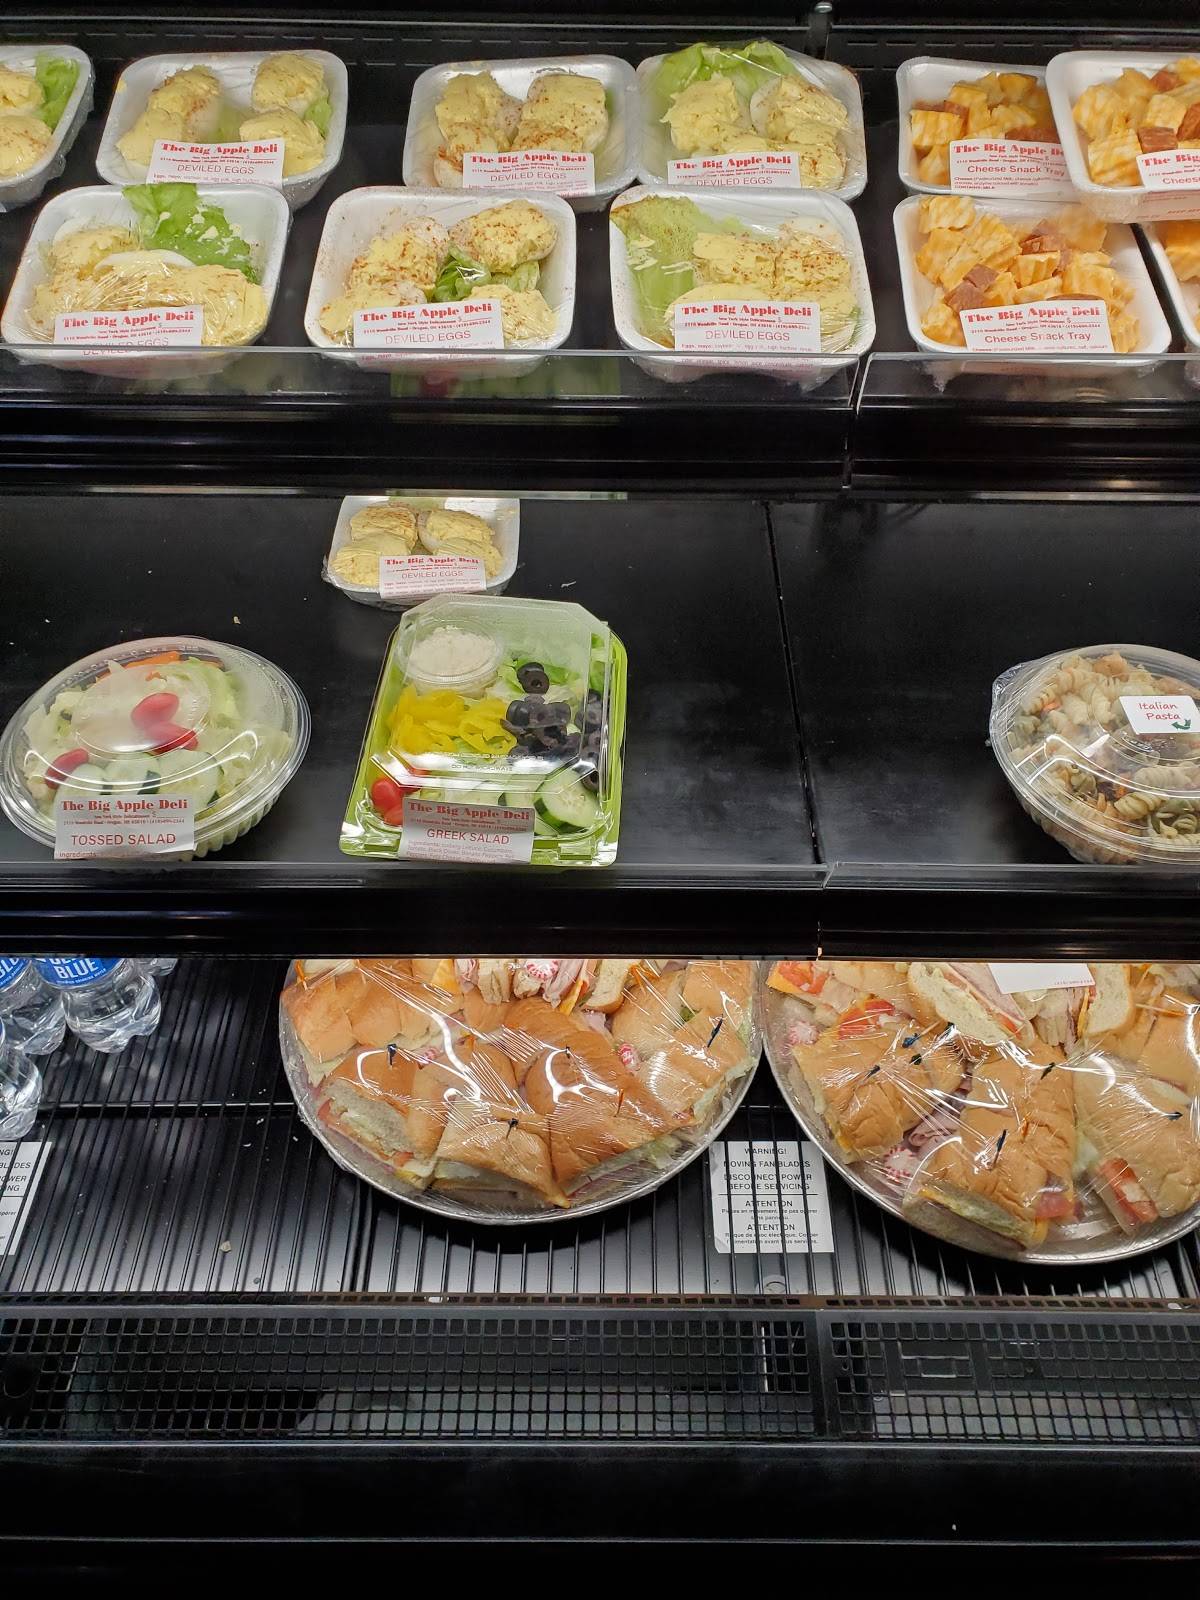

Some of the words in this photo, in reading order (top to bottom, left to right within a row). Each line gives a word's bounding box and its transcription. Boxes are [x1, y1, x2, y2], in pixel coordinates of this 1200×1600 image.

[161, 143, 186, 152] The
[190, 146, 210, 155] Big
[216, 145, 250, 155] Apple
[253, 144, 278, 154] Deli
[954, 145, 980, 153] The
[984, 143, 1006, 152] Big
[1010, 144, 1046, 155] Apple
[471, 155, 494, 163] The
[498, 155, 518, 163] Big
[524, 153, 557, 161] Apple
[702, 160, 723, 168] Big
[727, 156, 762, 167] Apple
[766, 156, 791, 164] Deli
[1142, 158, 1171, 167] The
[177, 164, 221, 173] DEVILED
[225, 165, 255, 174] EGGS
[967, 165, 1007, 173] Cheese
[1009, 165, 1042, 173] Snack
[1044, 167, 1065, 177] Tray
[490, 172, 534, 182] DEVILED
[696, 177, 740, 187] DEVILED
[743, 176, 773, 185] EGGS
[361, 312, 387, 322] The
[392, 311, 415, 320] Big
[420, 307, 460, 319] Apple
[464, 303, 492, 313] Deli
[681, 306, 708, 315] The
[713, 304, 736, 315] Big
[740, 304, 779, 316] Apple
[783, 306, 812, 317] Deli
[965, 314, 993, 323] The
[998, 310, 1024, 321] Big
[1028, 307, 1068, 318] Apple
[1072, 306, 1100, 316] Deli
[63, 318, 89, 328] The
[93, 317, 117, 328] Big
[122, 313, 161, 326] Apple
[166, 311, 194, 321] Deli
[385, 333, 435, 345] DEVILED
[438, 330, 471, 342] EGGS
[705, 330, 754, 340] DEVILED
[757, 331, 790, 341] EGGS
[984, 335, 1027, 344] Cheese
[1030, 332, 1064, 341] Snack
[1069, 331, 1092, 342] Tray
[1139, 702, 1178, 710] Italian
[1146, 712, 1181, 720] Pasta
[63, 801, 84, 810] The
[88, 800, 110, 812] Big
[116, 800, 154, 812] Apple
[159, 799, 188, 809] Deli
[408, 801, 433, 813] The
[437, 805, 459, 817] Big
[463, 807, 499, 819] Apple
[503, 810, 530, 820] Deli
[72, 833, 124, 845] TOSSED
[128, 833, 176, 845] SALAD
[426, 828, 467, 841] GREEK
[469, 833, 510, 845] SALAD
[54, 958, 98, 979] BLUE
